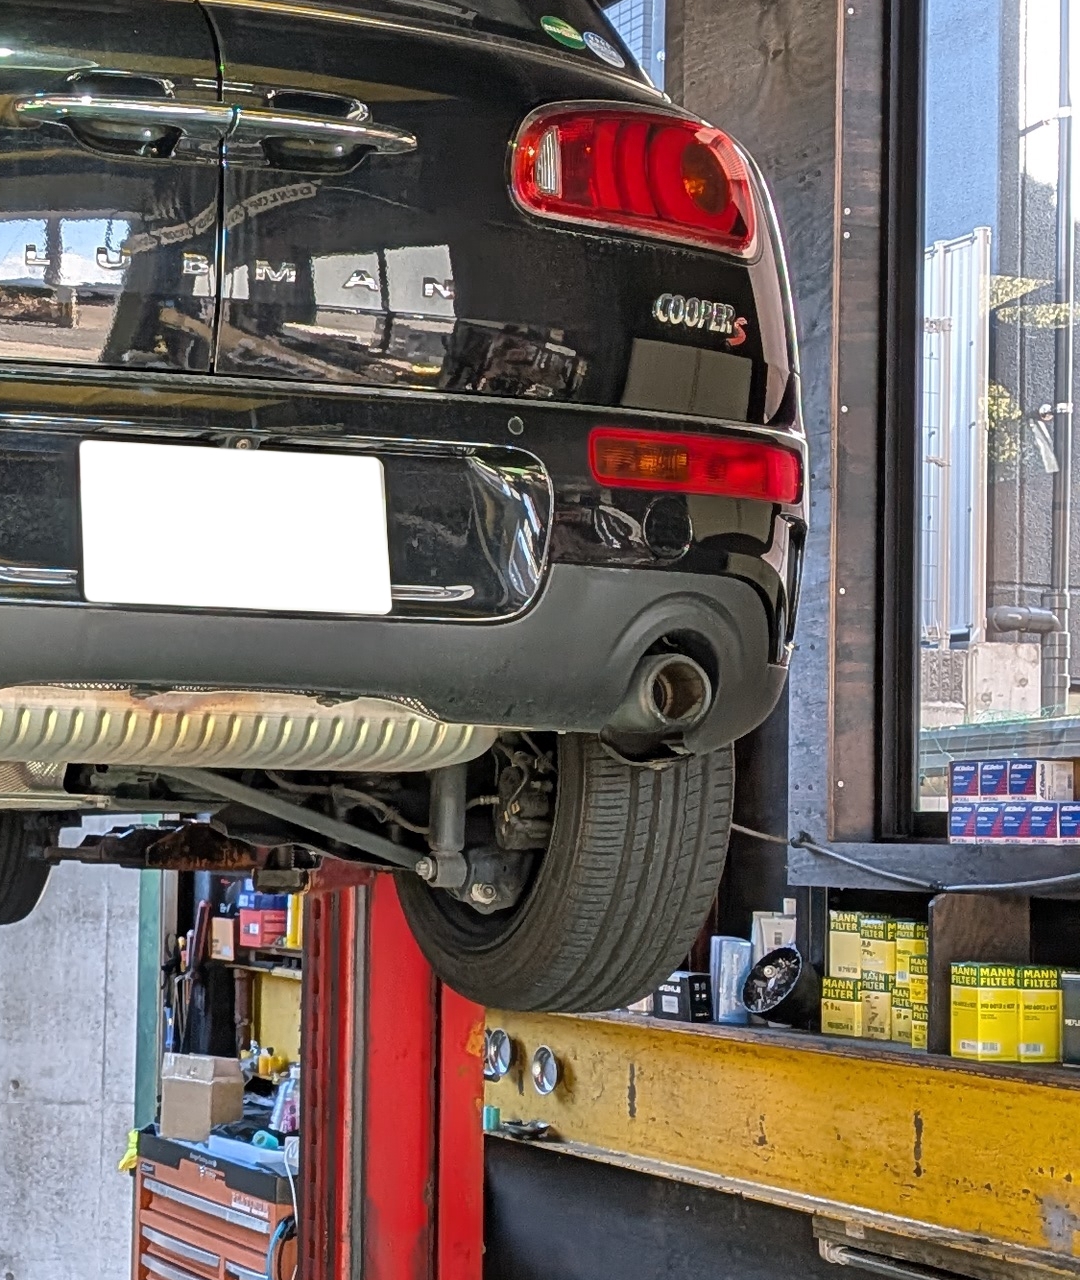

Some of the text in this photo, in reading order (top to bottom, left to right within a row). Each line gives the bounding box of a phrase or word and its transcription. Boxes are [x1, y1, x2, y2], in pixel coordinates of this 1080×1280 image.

[980, 968, 1015, 978] MANN
[1023, 969, 1057, 979] MANN
[823, 978, 853, 990] MANN
[981, 977, 1015, 987] FILTER
[1024, 979, 1058, 988] FILTER
[822, 988, 853, 1000] FILTER
